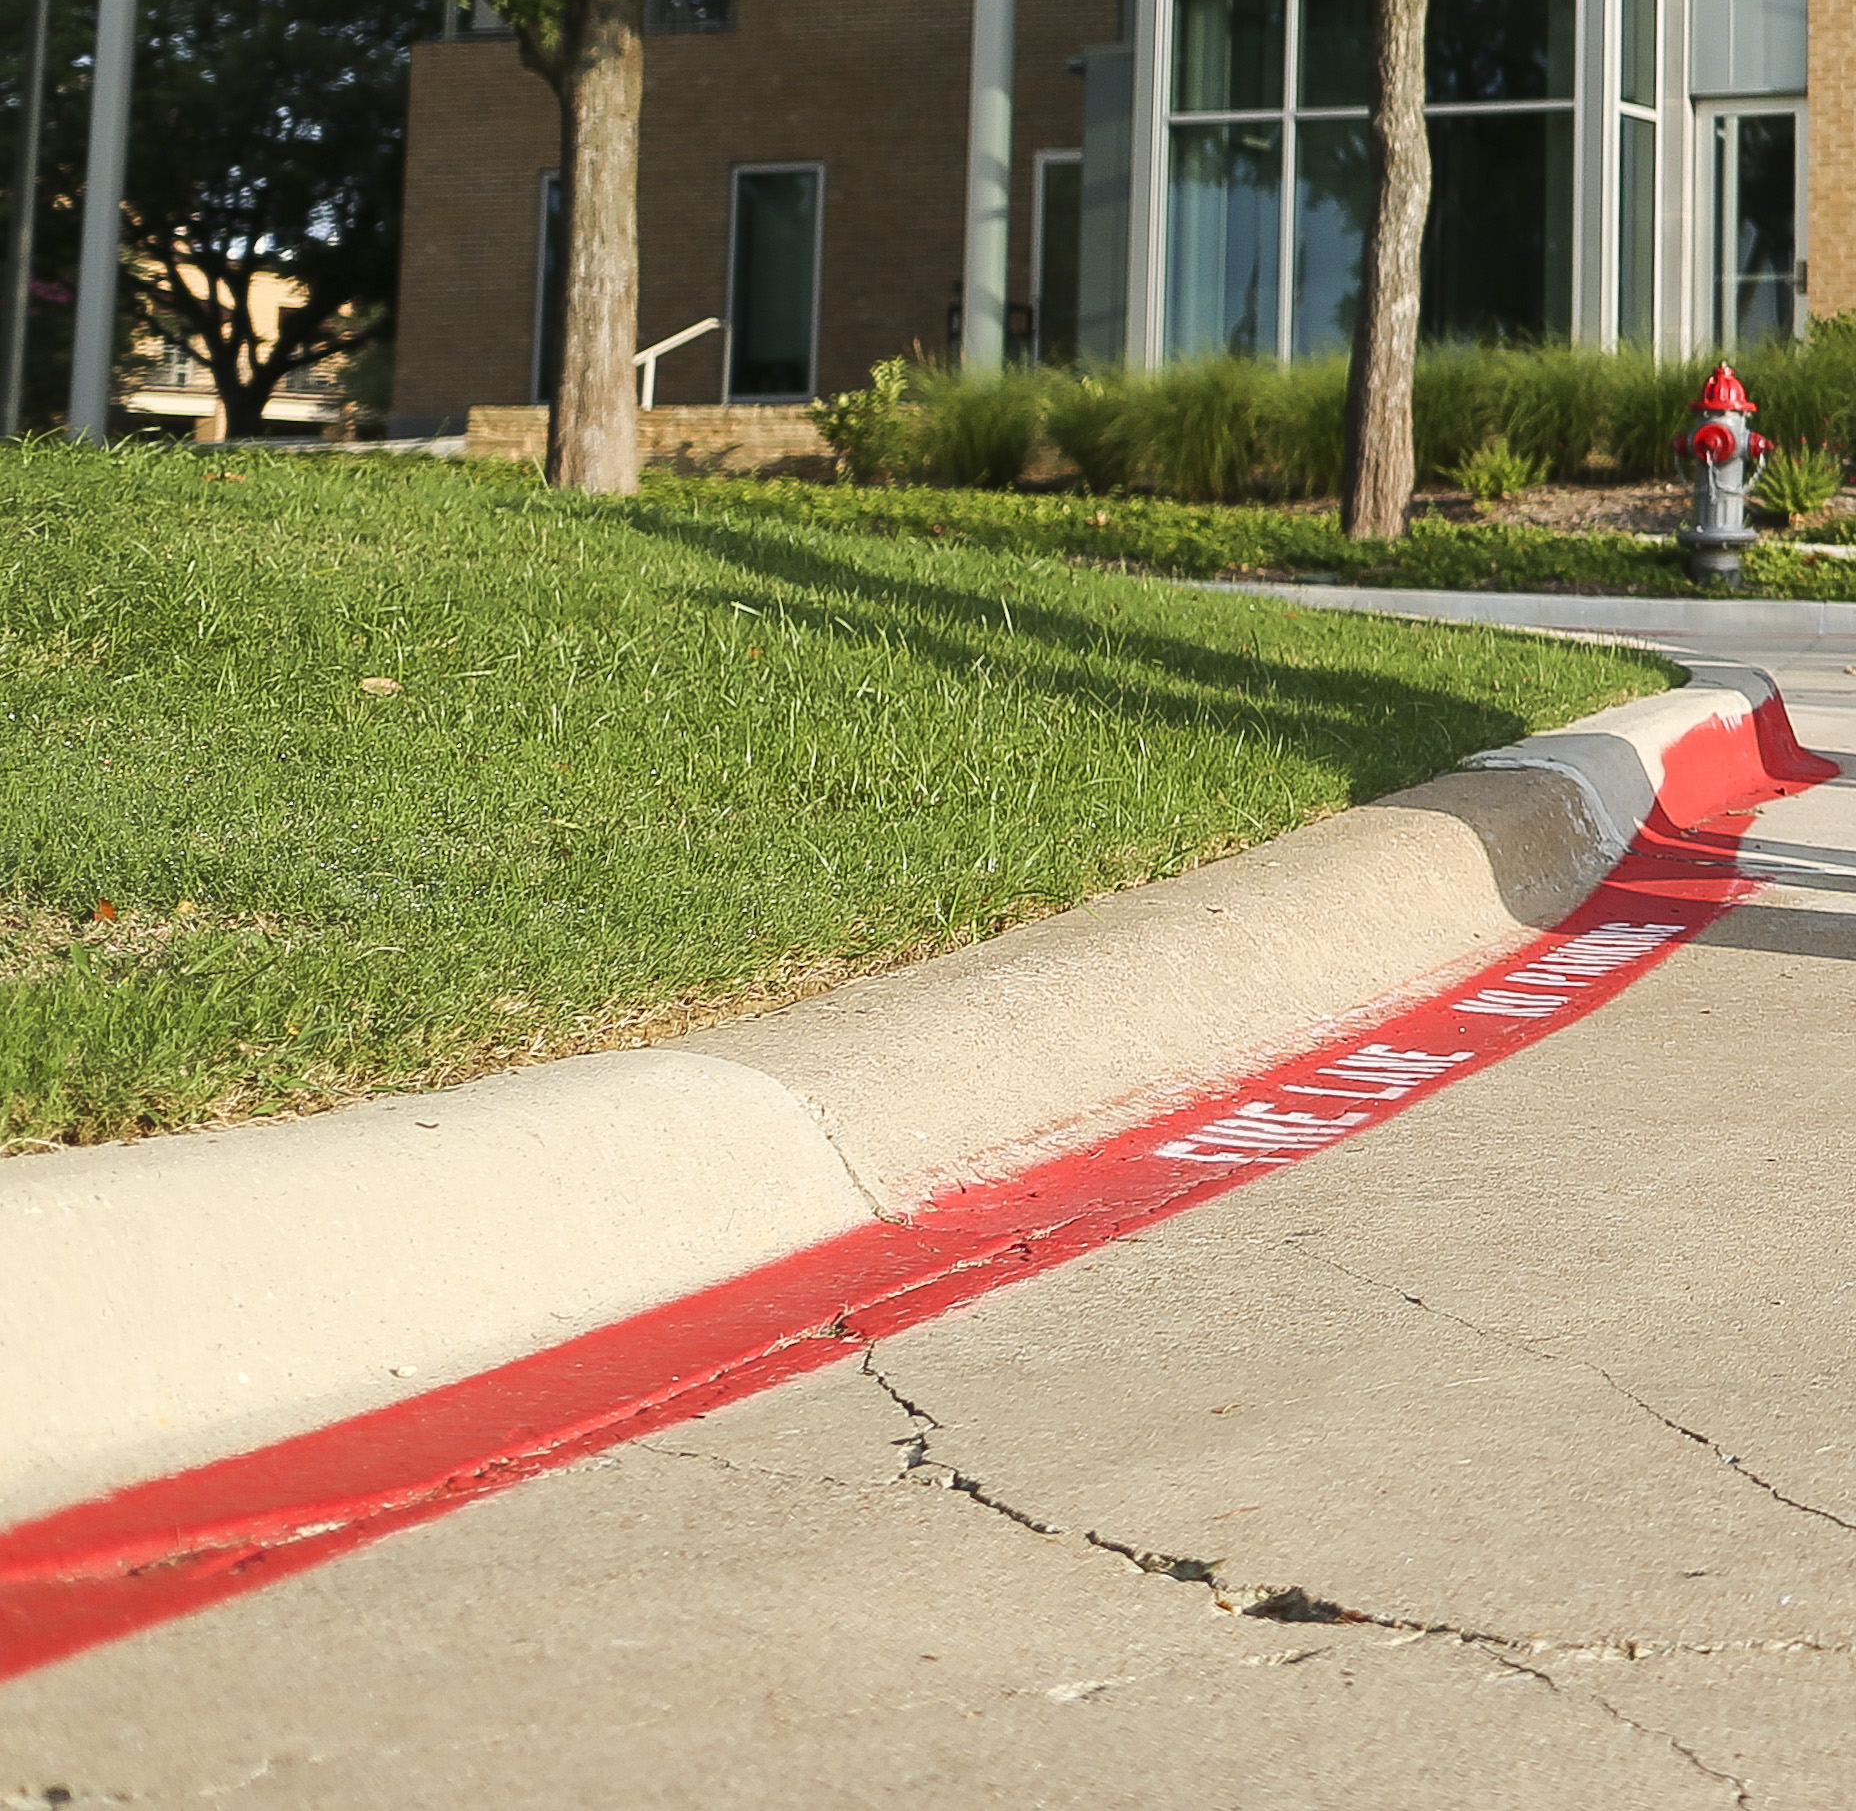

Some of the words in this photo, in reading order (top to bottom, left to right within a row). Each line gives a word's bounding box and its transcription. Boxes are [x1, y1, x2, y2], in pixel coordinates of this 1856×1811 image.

[1503, 921, 1688, 987] PARKING
[1451, 989, 1572, 1018] NO
[1281, 1042, 1476, 1101] LANE
[1153, 1100, 1374, 1164] FIRE
